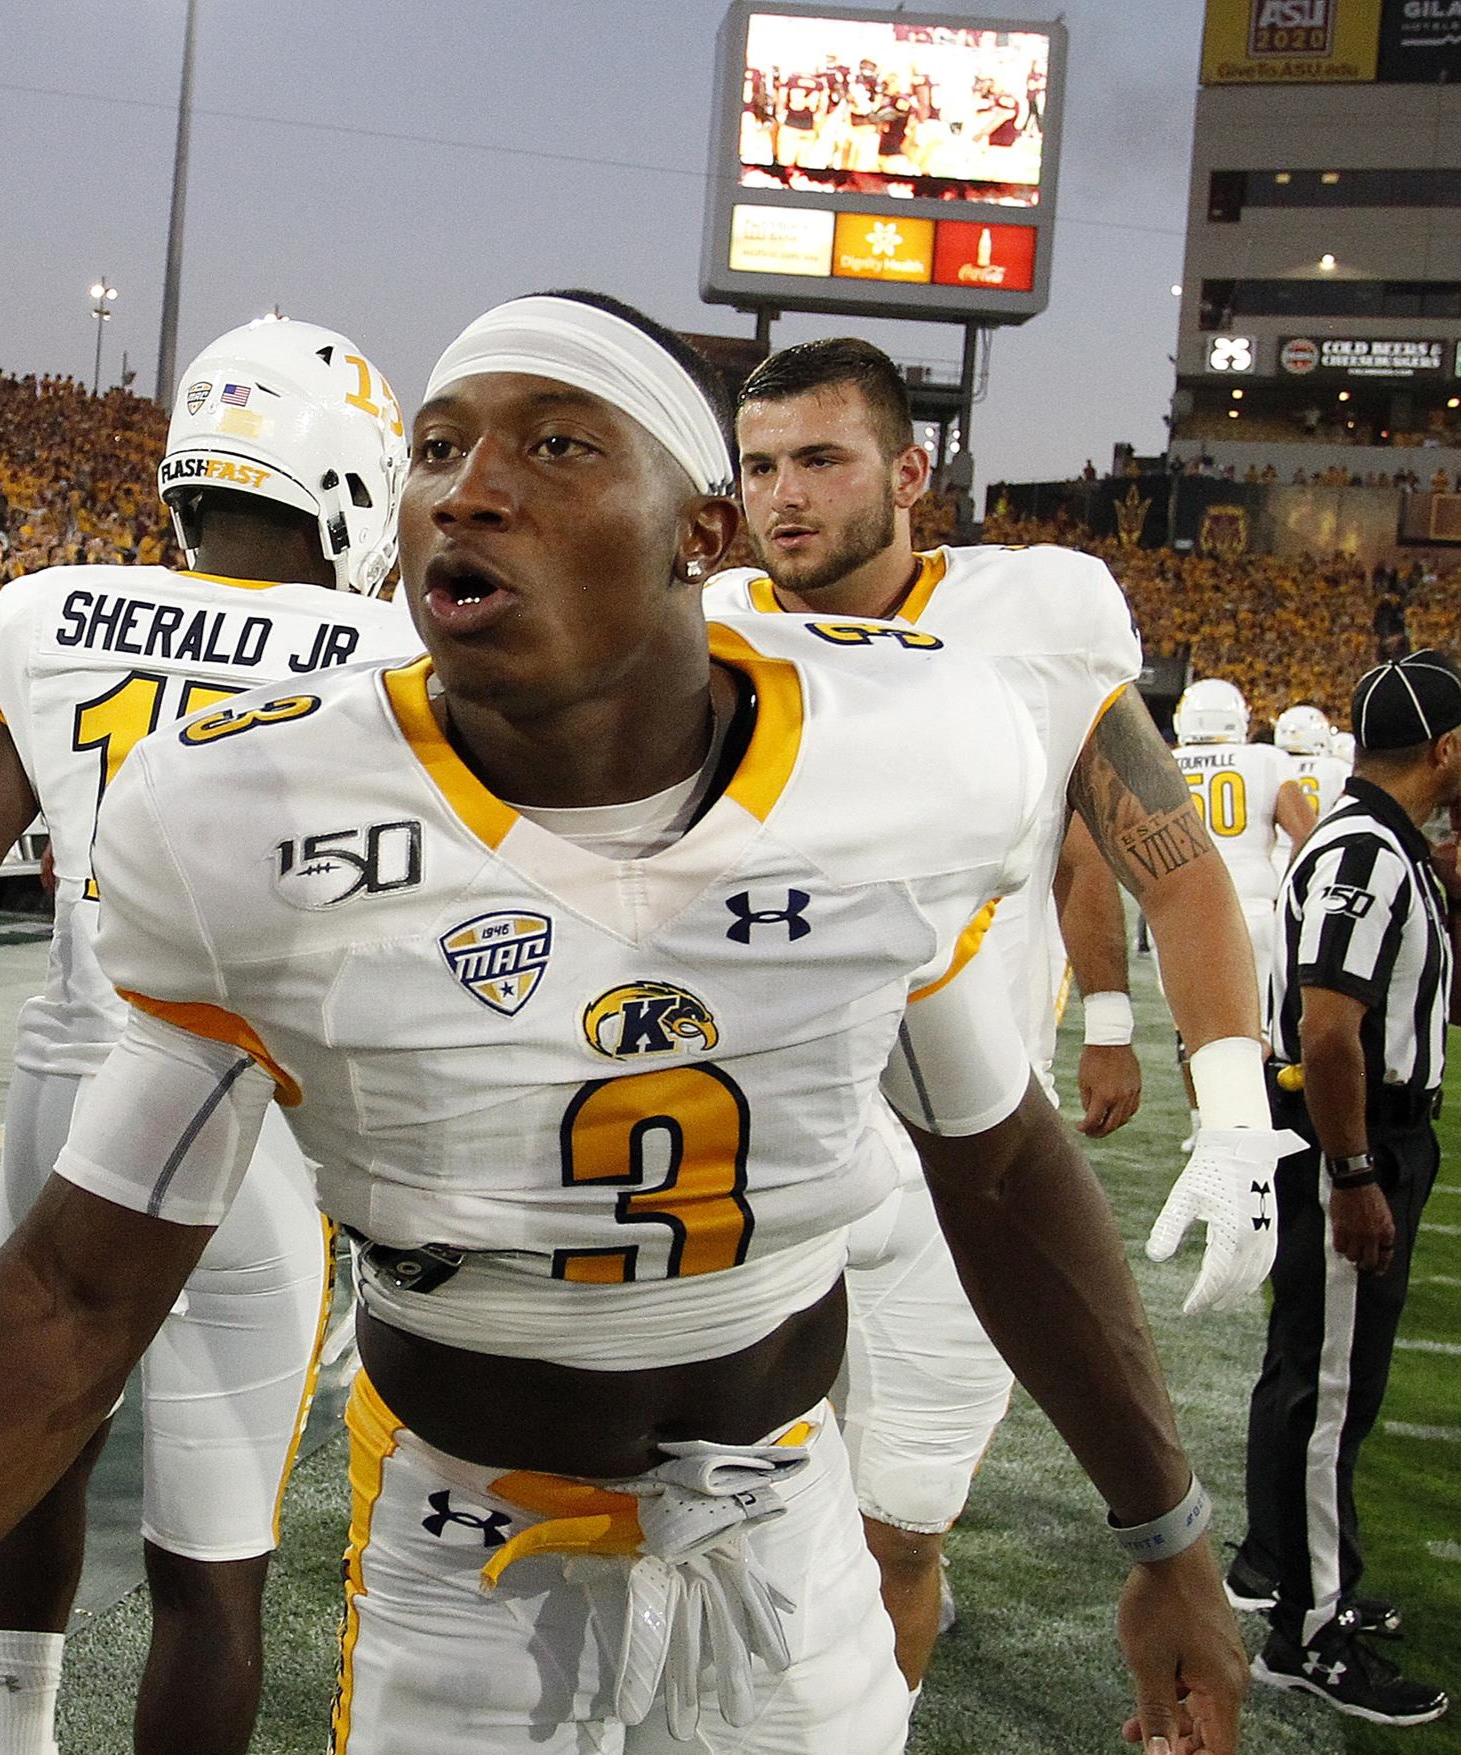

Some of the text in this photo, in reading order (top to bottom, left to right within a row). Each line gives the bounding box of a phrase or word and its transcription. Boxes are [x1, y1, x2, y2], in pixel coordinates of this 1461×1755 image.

[1259, 0, 1325, 27] ASU
[1256, 30, 1323, 49] 2020
[1322, 341, 1369, 355] COLD
[1371, 342, 1429, 356] BEERS
[56, 590, 359, 673] SHERALD JR
[804, 623, 944, 650] 3
[178, 695, 322, 746] 3
[276, 820, 422, 906] 150
[1322, 886, 1376, 919] 150
[482, 923, 510, 940] 1946
[454, 939, 550, 981] MAC
[551, 1061, 755, 1284] 3
